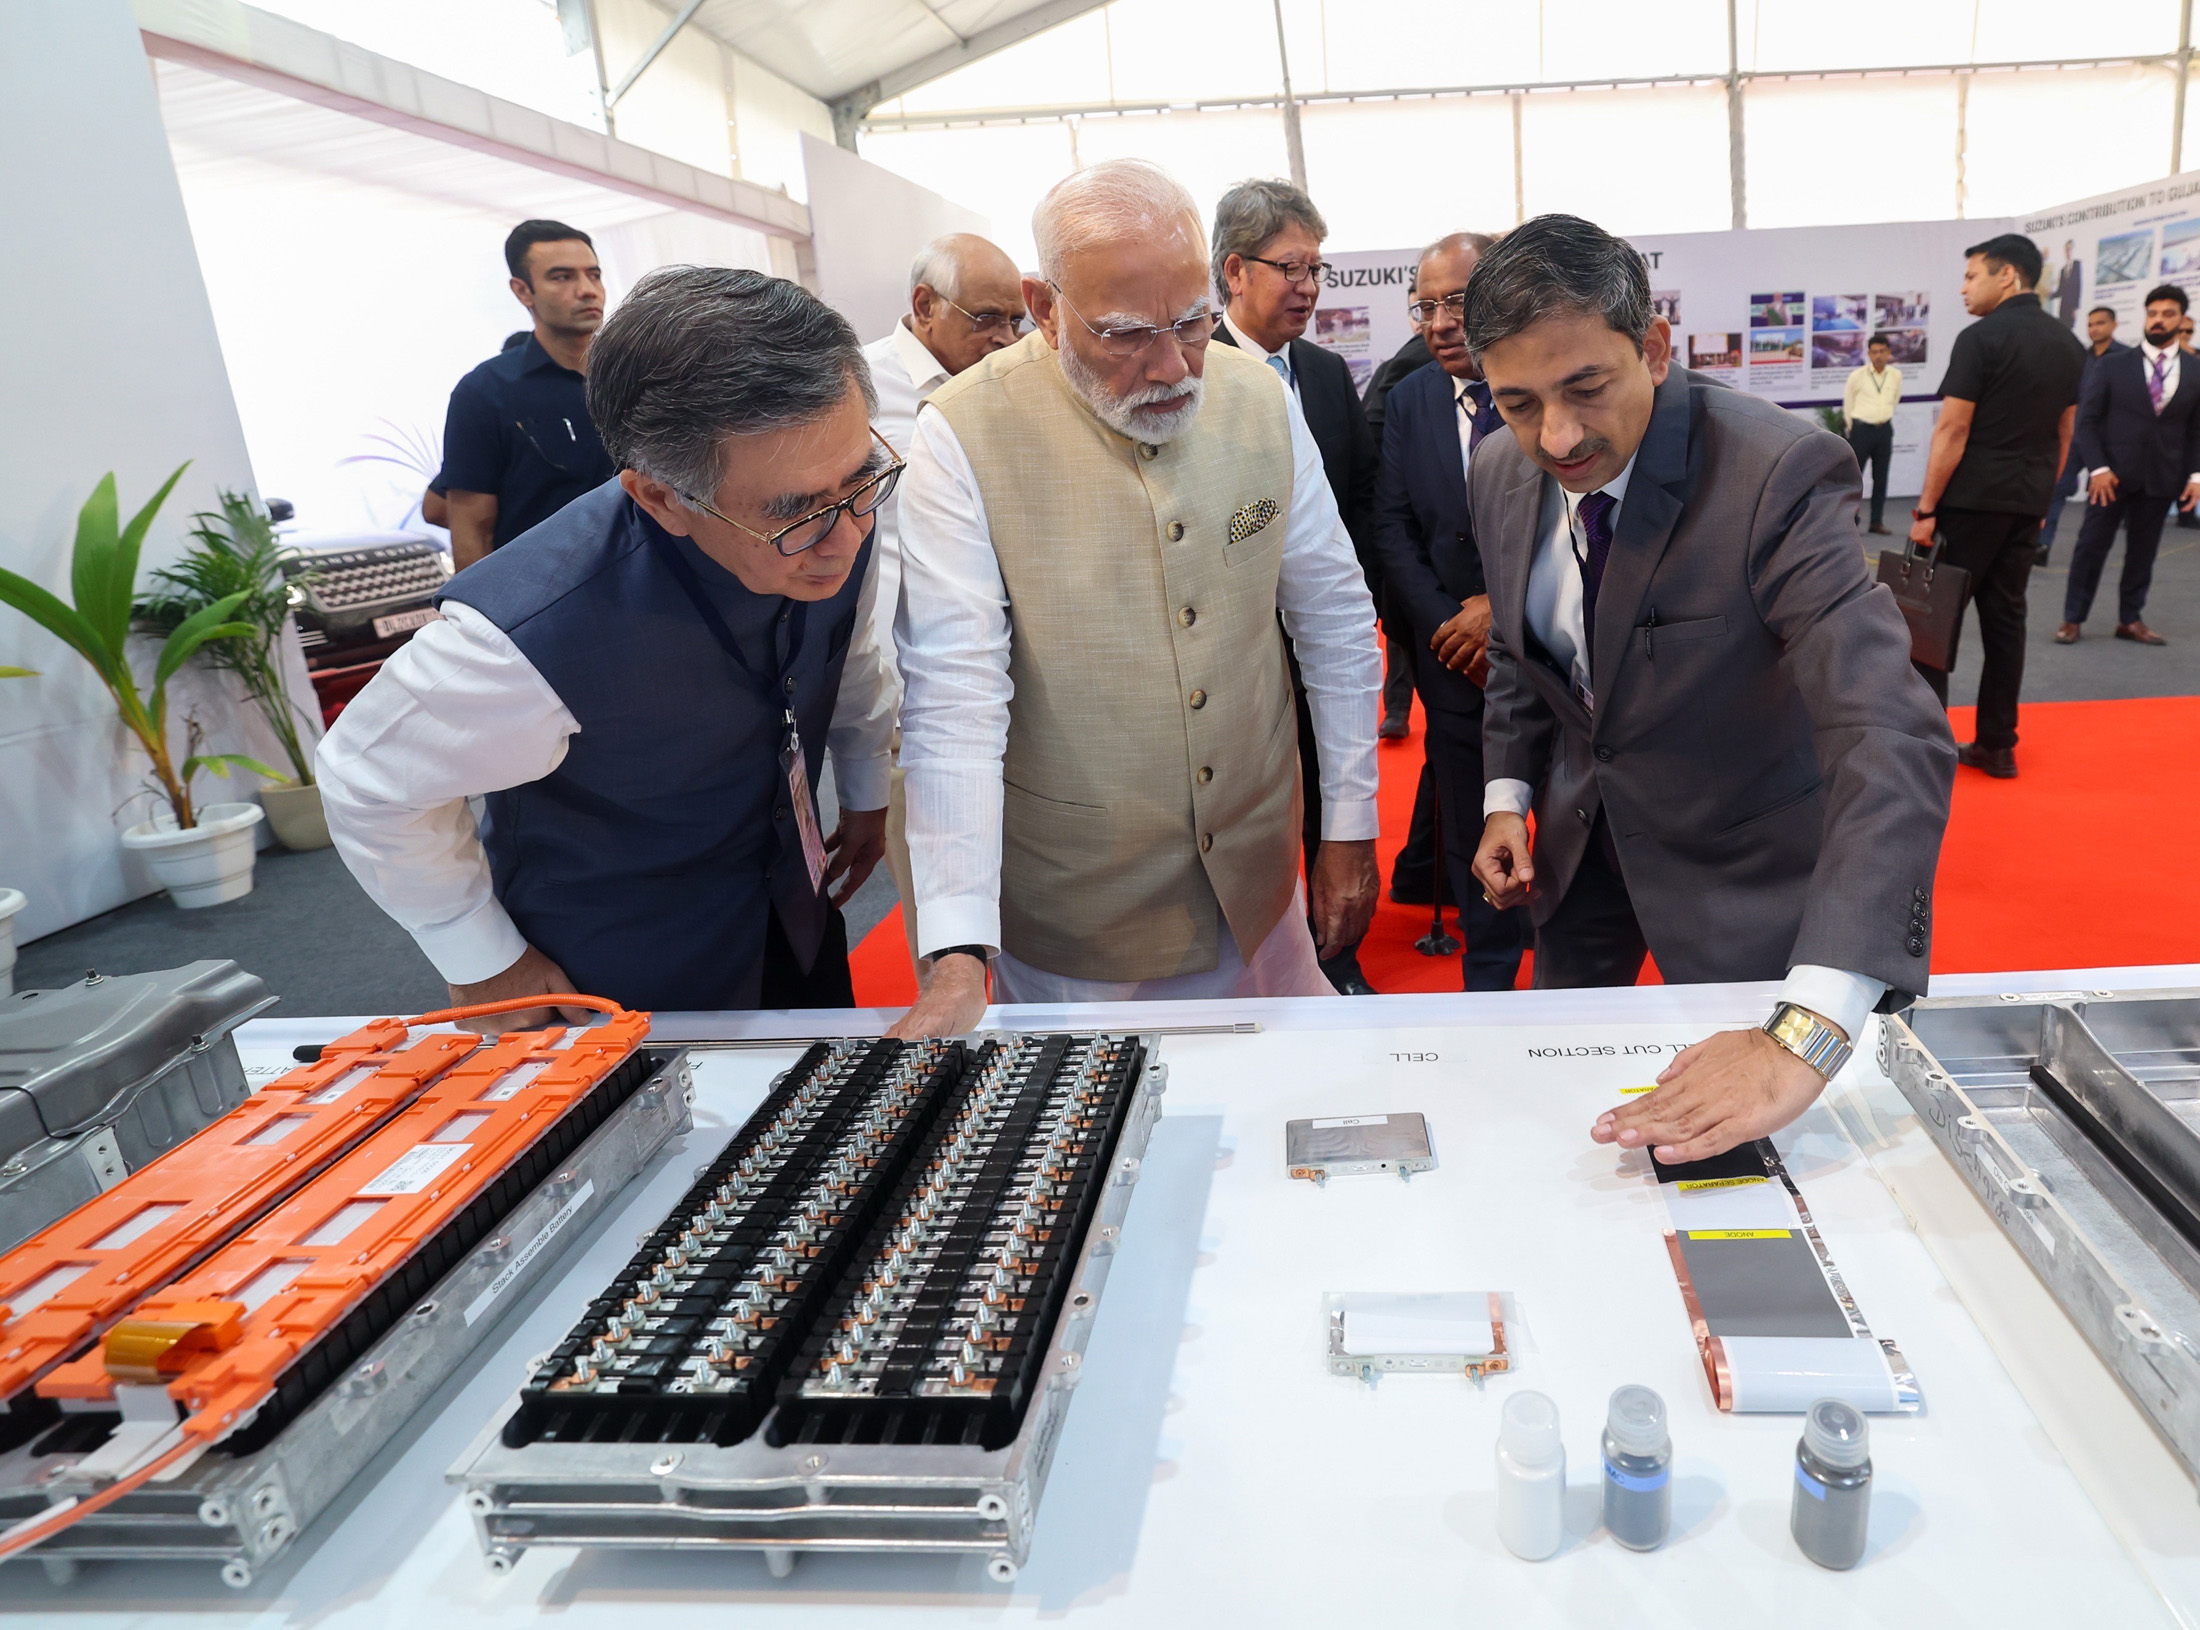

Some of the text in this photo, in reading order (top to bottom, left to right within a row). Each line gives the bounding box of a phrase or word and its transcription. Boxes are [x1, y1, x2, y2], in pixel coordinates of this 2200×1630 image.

[1528, 1045, 1616, 1058] SECTION
[1622, 1044, 1662, 1055] CUT
[1389, 1052, 1439, 1062] CELL
[1686, 1177, 1765, 1189] ANODE SEPARATOR
[492, 1205, 573, 1294] Stack Assemble Battery
